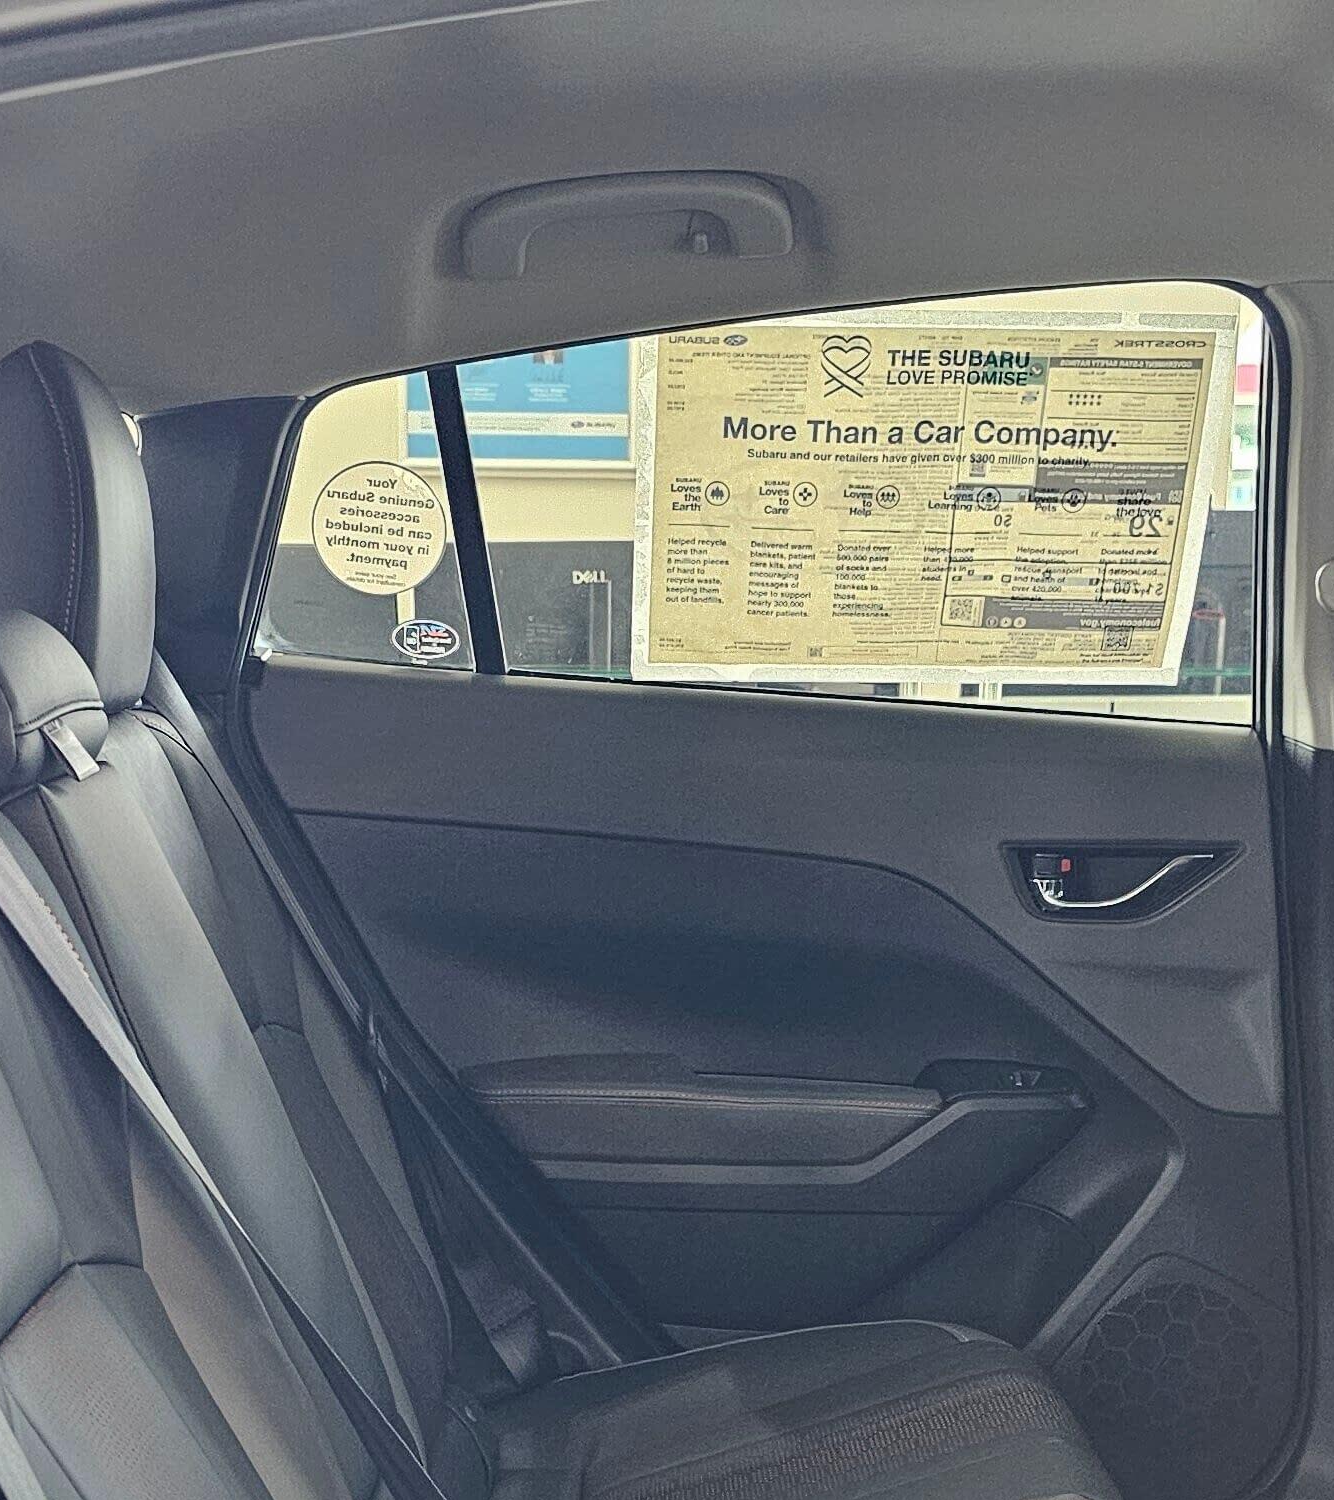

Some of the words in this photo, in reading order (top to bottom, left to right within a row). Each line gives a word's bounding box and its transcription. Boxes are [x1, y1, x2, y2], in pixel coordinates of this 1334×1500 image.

[888, 350, 931, 367] THE
[938, 350, 1030, 369] SUBARU
[886, 370, 934, 385] LOVE
[723, 416, 797, 441] More
[807, 420, 877, 444] Than
[887, 426, 903, 444] a
[913, 420, 965, 444] Car
[974, 420, 1117, 452] Company.
[747, 448, 787, 459] Subaru
[789, 451, 810, 460] and
[835, 453, 879, 463] retailers
[882, 454, 907, 463] have
[910, 454, 939, 465] given
[943, 455, 967, 463] over
[970, 453, 995, 464] $300
[998, 454, 1035, 465] million
[1038, 456, 1048, 465] to
[670, 483, 702, 493] Loves
[759, 486, 790, 496] Loves
[684, 493, 701, 502] the
[843, 489, 873, 499] Loves
[672, 502, 701, 511] Earth
[779, 497, 789, 506] to
[862, 500, 872, 508] to
[928, 500, 973, 512] Learning
[764, 506, 790, 515] Care
[849, 507, 872, 517] Help
[668, 538, 696, 546] Helped
[697, 539, 727, 547] recycle
[750, 540, 788, 550] Delivered
[788, 552, 816, 561] patient
[677, 567, 695, 575] hard
[749, 571, 799, 581] encouraging
[666, 586, 697, 594] keeping
[748, 590, 768, 598] hope
